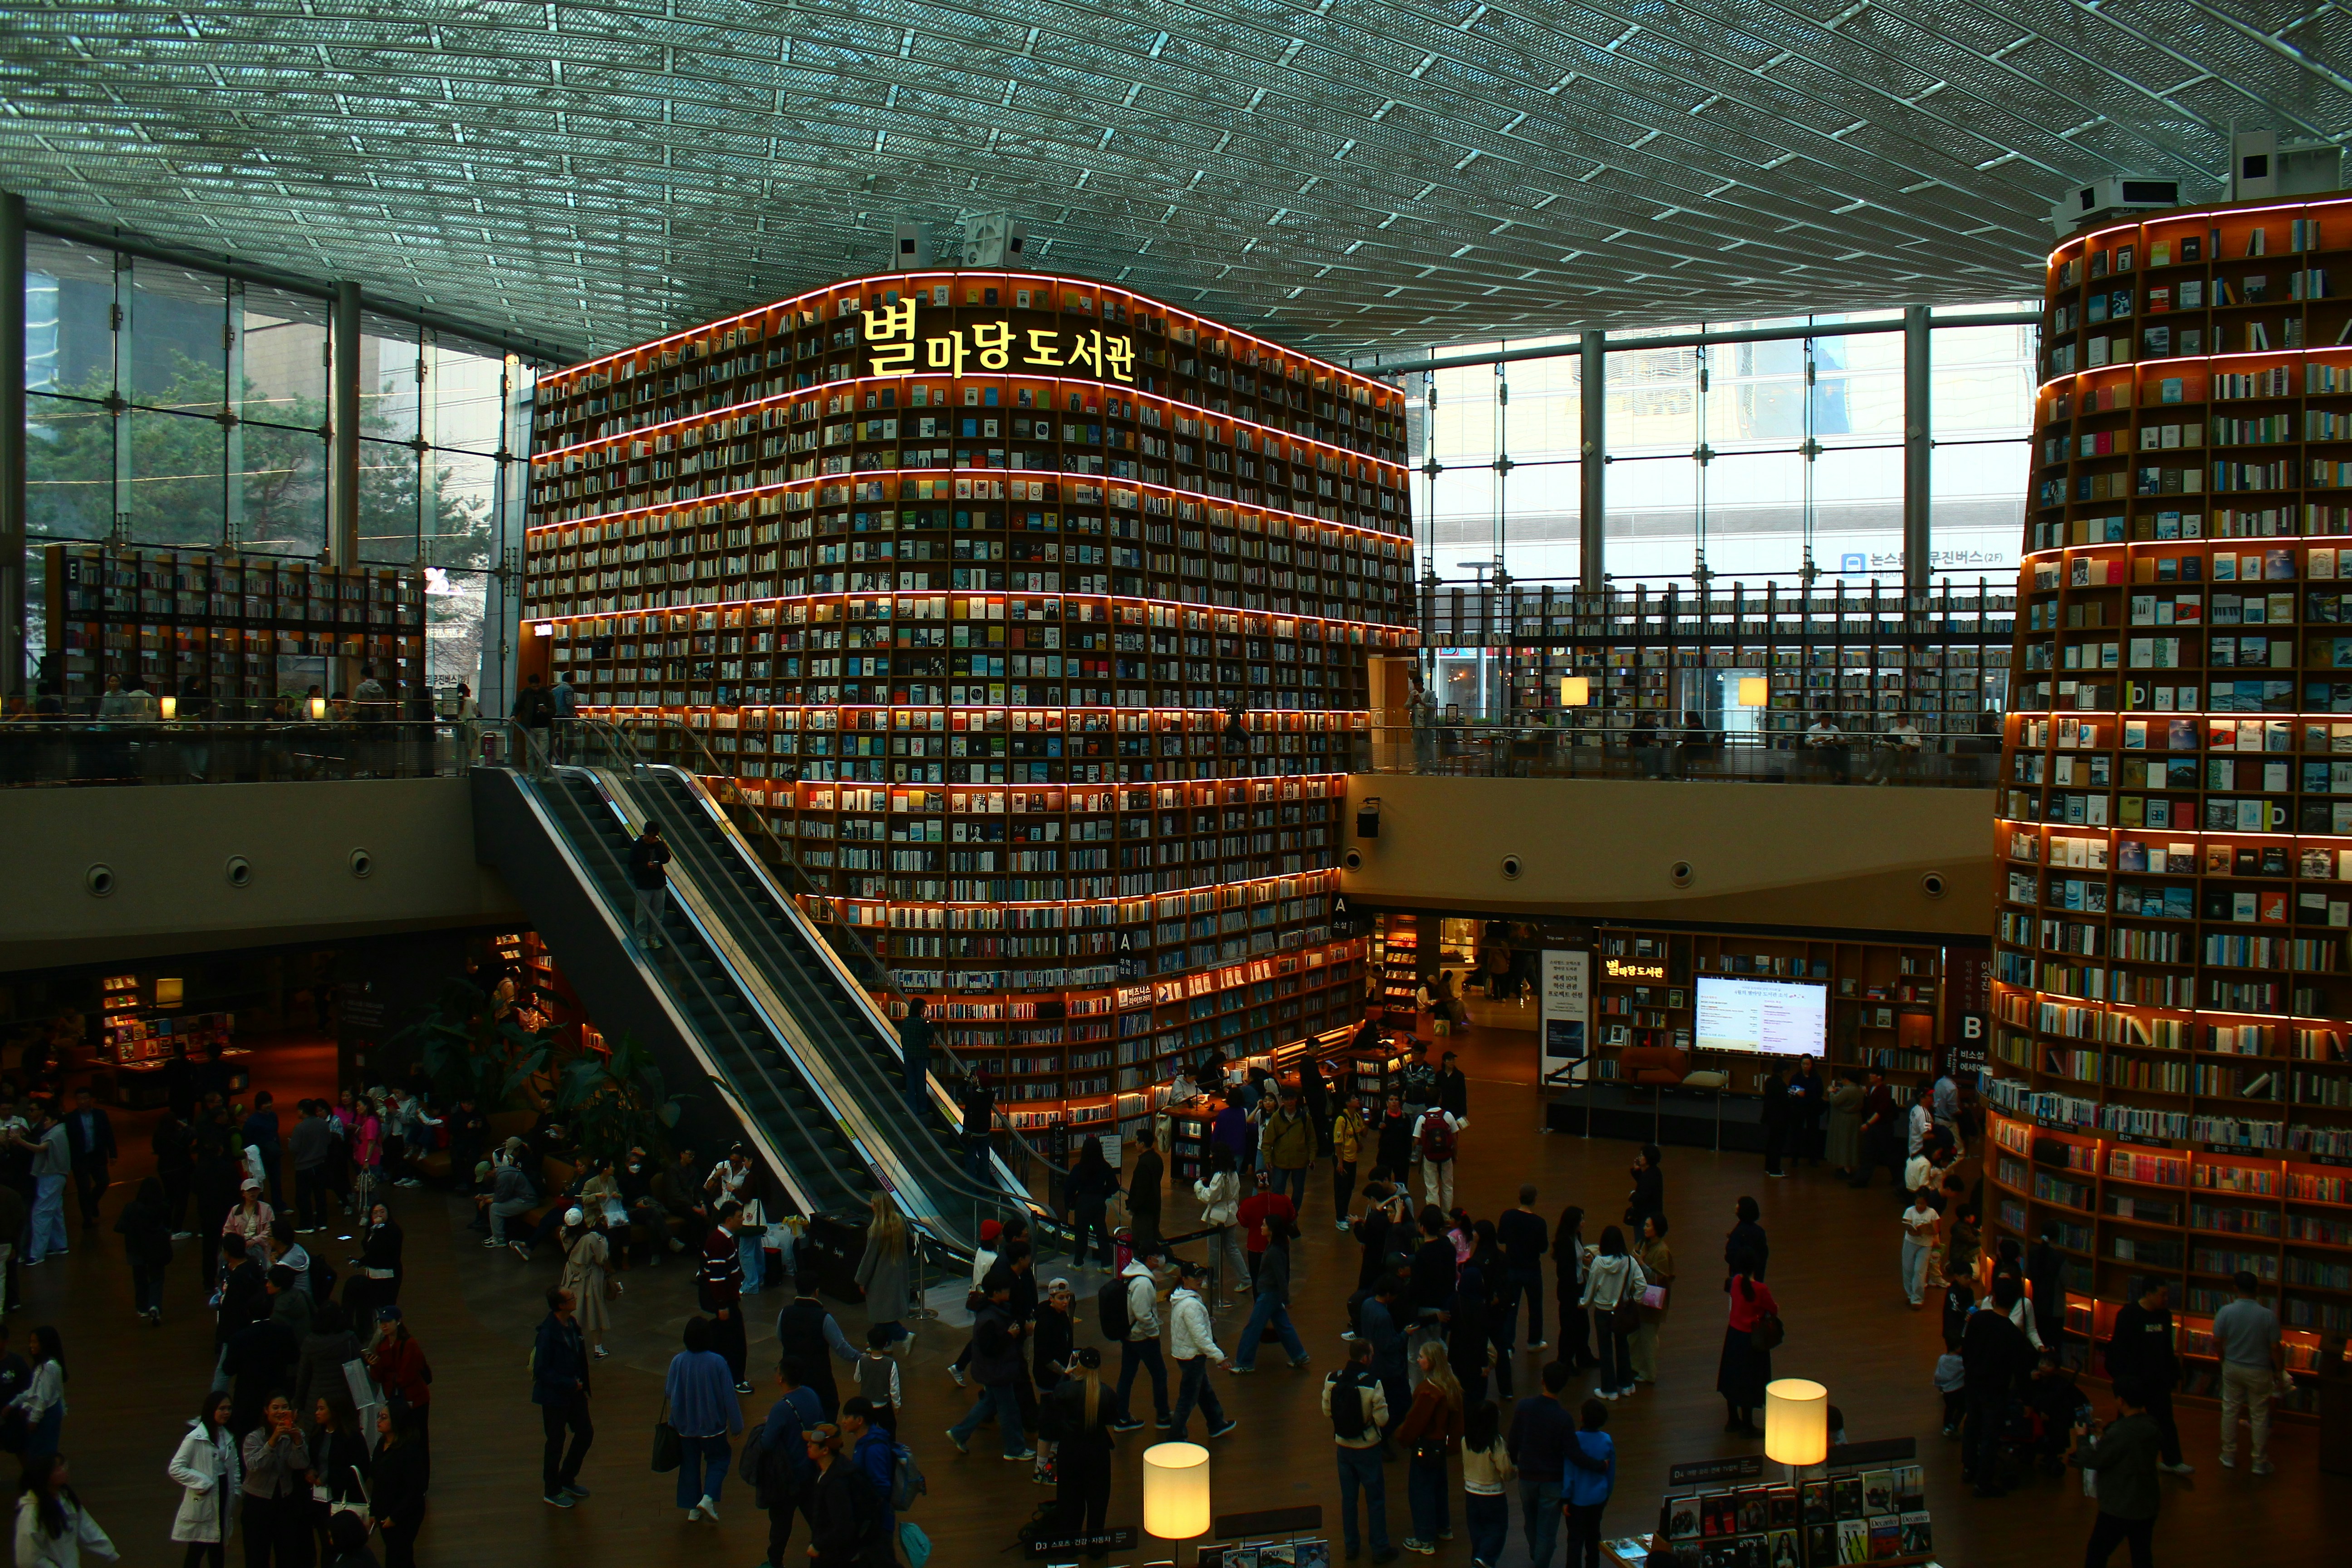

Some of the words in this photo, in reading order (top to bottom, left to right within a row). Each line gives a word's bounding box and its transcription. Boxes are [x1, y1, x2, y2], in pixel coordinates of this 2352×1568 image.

[861, 297, 1016, 379] 별마당
[1023, 329, 1136, 382] 도서관
[69, 563, 76, 579] E
[2133, 686, 2145, 704] D
[2272, 808, 2286, 825] D
[1335, 898, 1346, 912] A
[1121, 933, 1130, 951] A
[1120, 958, 1130, 967] 무역
[1606, 959, 1637, 977] 별마당
[1637, 967, 1664, 978] 도서관
[1120, 967, 1130, 975] 협회
[1128, 985, 1151, 997] 비즈니스
[1129, 994, 1152, 1006] 라이브러리
[1964, 1016, 1982, 1039] B
[1960, 1050, 1985, 1061] 비소설
[2119, 1133, 2132, 1142] B29
[1674, 1470, 1684, 1479] D4
[1872, 1519, 1898, 1527] Decanter
[1035, 1542, 1047, 1551] D3
